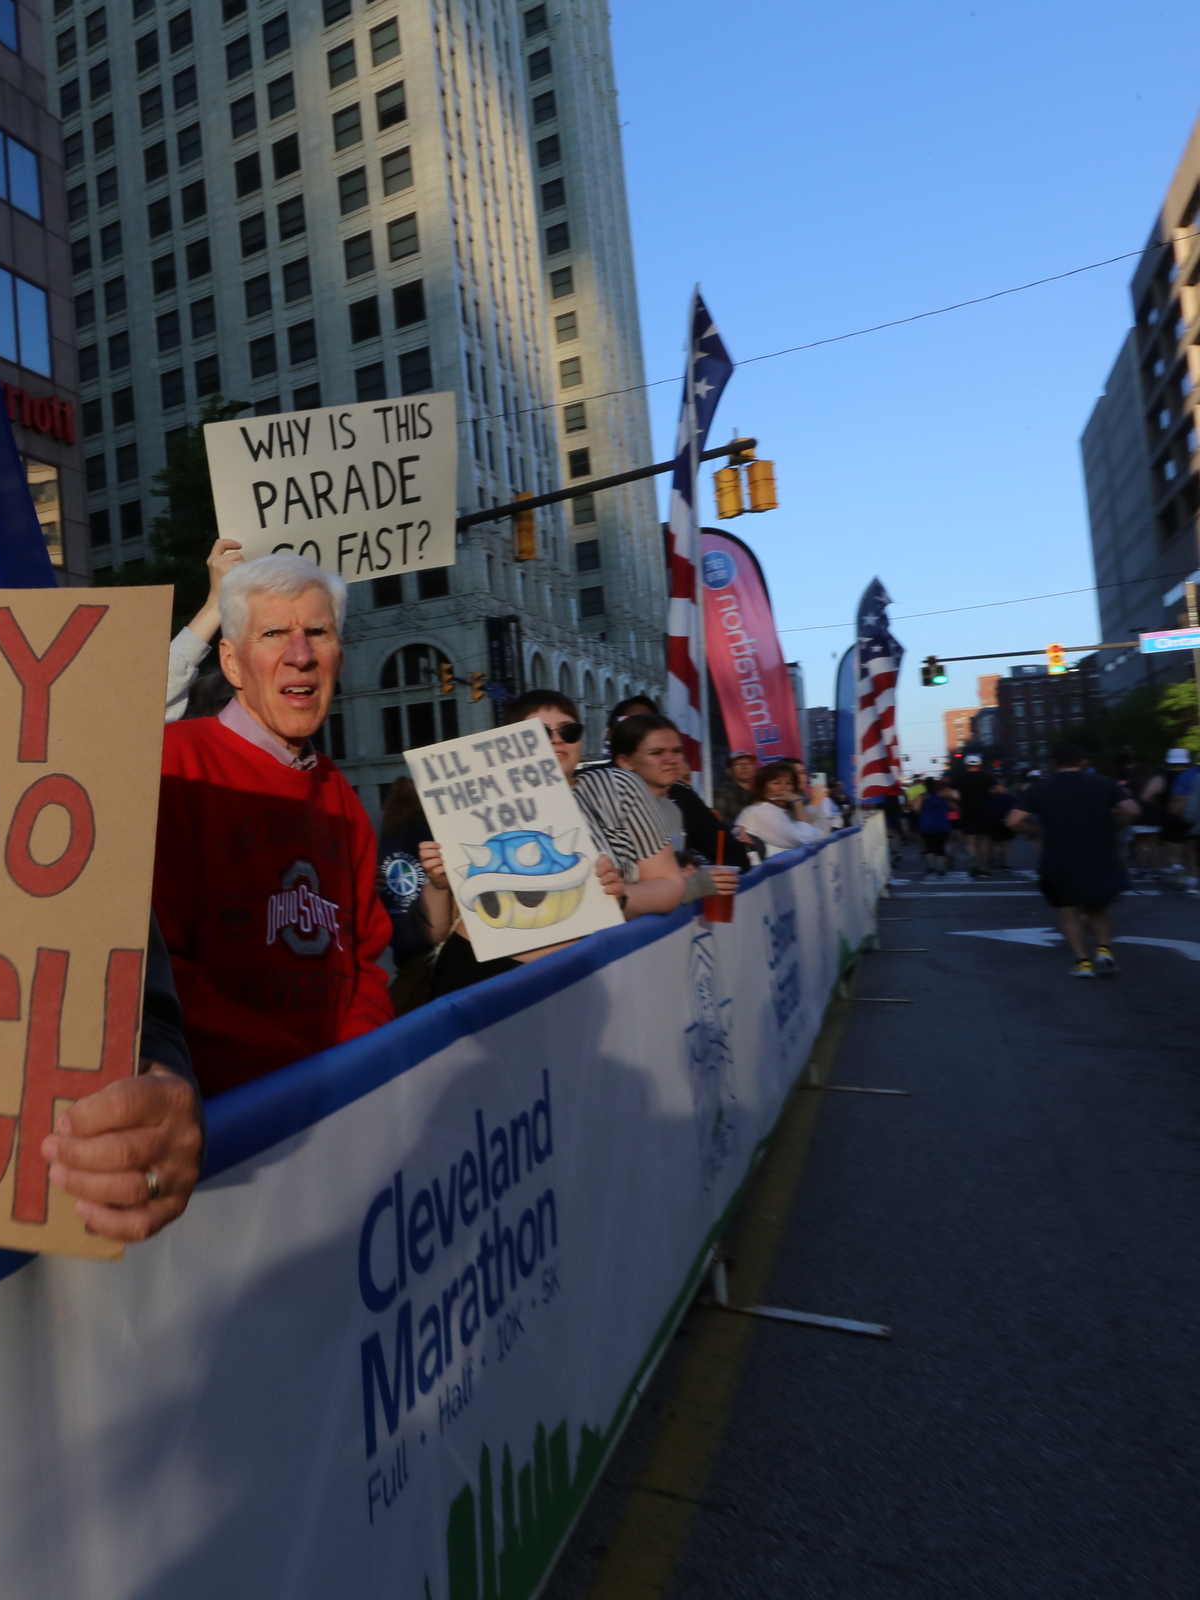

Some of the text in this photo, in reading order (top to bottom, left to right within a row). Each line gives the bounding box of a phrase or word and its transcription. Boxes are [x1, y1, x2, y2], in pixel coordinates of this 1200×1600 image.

[240, 402, 433, 463] WHY IS THIS
[252, 454, 422, 529] PARADE
[337, 520, 431, 576] FAST?
[421, 729, 539, 784] I'LL TRIP
[423, 757, 562, 816] THEM FOR
[469, 797, 538, 834] YOU
[266, 884, 344, 953] OHIO STATE
[358, 1067, 554, 1314] Cleveland
[360, 1187, 558, 1462] Marathon
[368, 1437, 409, 1527] Full
[438, 1356, 474, 1437] Half
[496, 1301, 526, 1363] 10K
